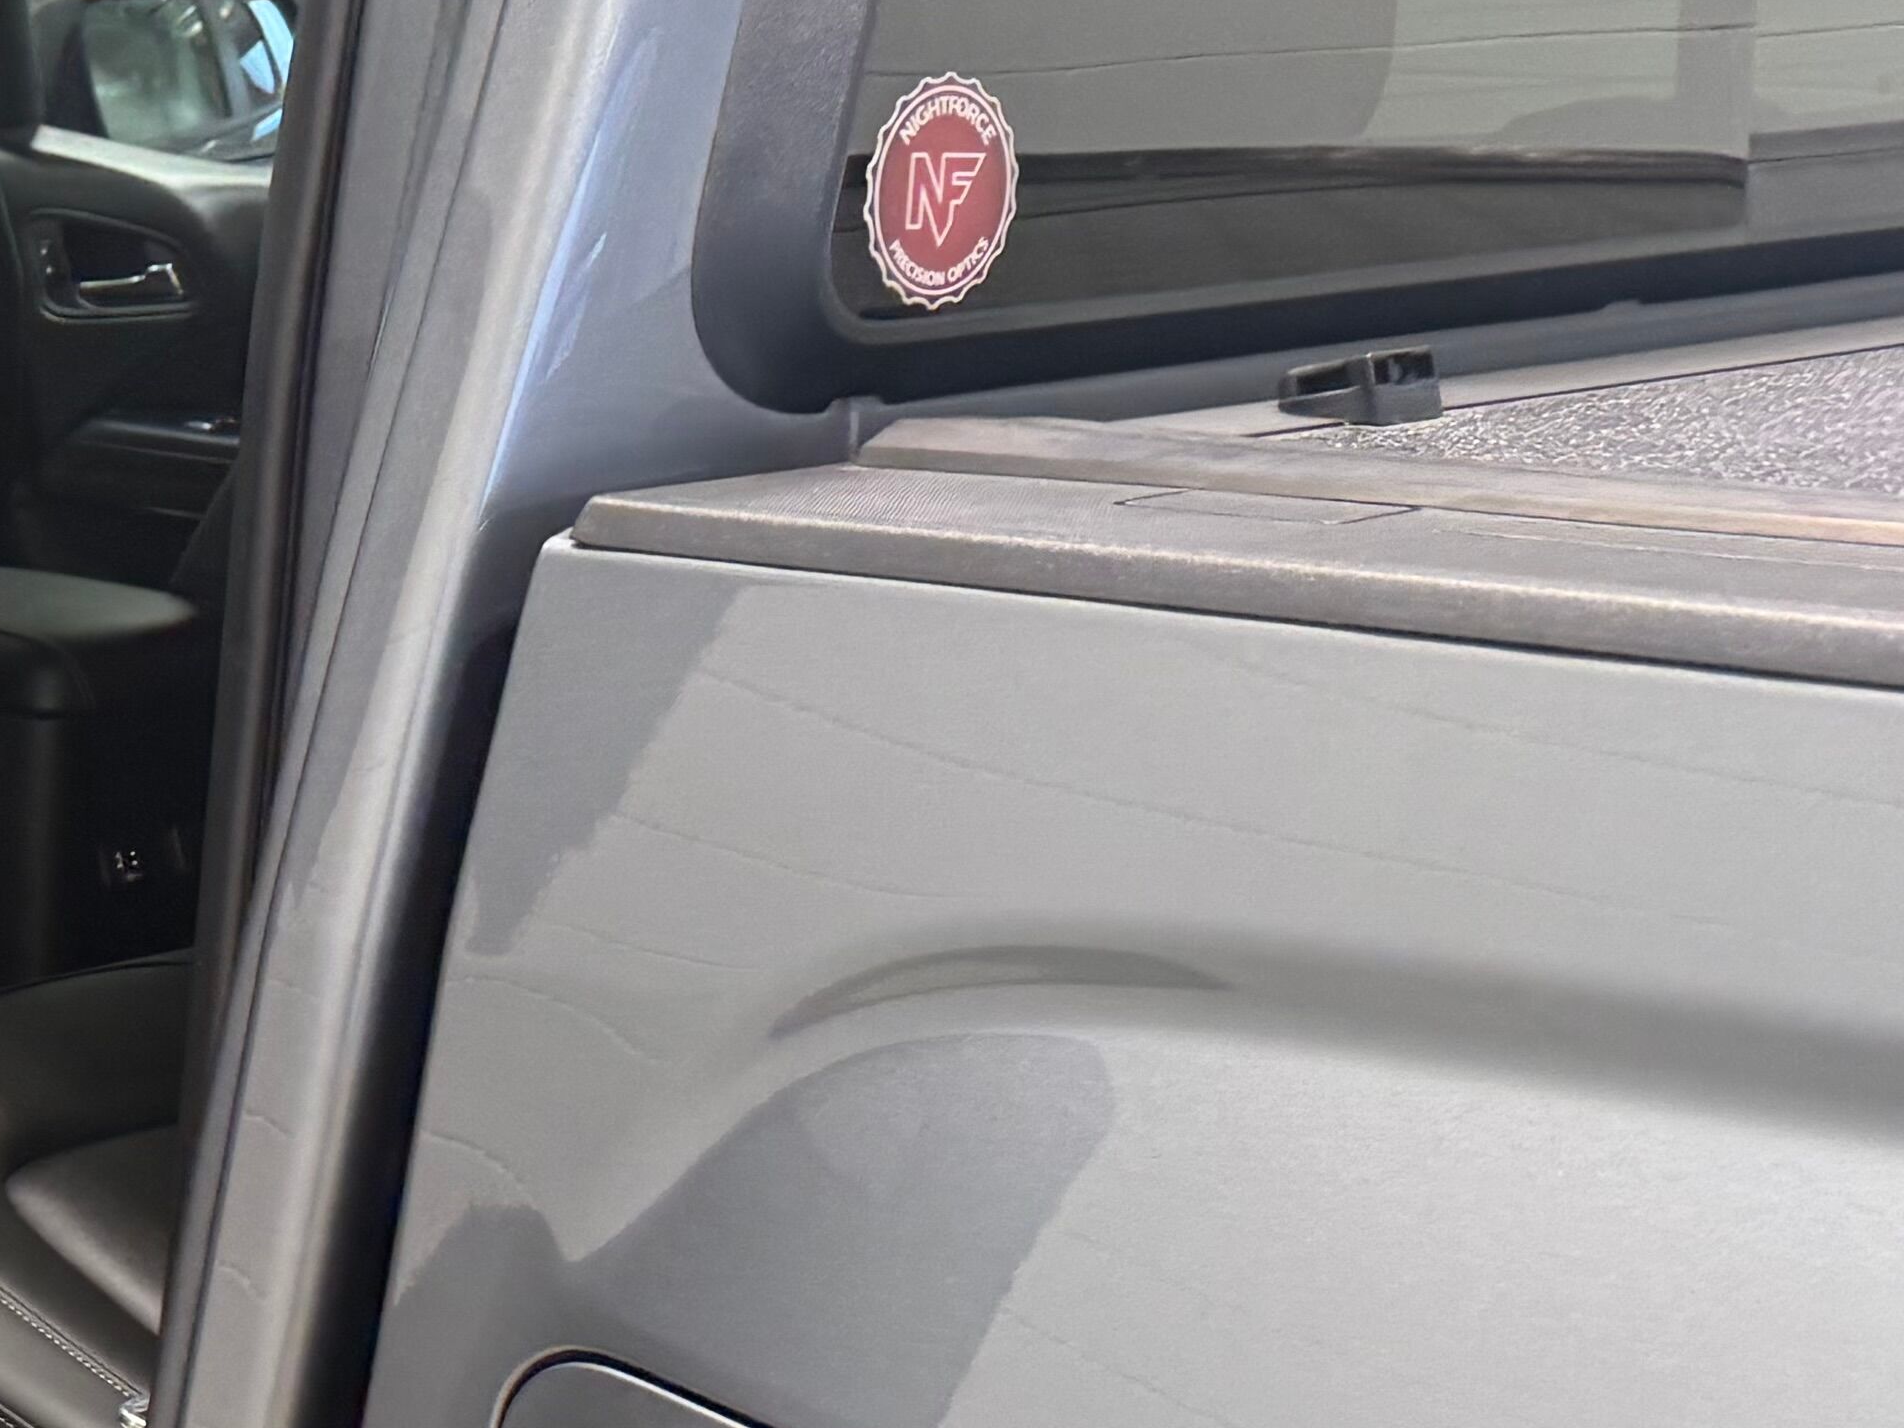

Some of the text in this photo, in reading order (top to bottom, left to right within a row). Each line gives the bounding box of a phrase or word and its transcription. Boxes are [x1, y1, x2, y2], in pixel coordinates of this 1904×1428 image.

[899, 95, 997, 146] NIGHTFORCE
[905, 152, 987, 248] NF
[889, 236, 990, 286] PRECISION OPTICS
